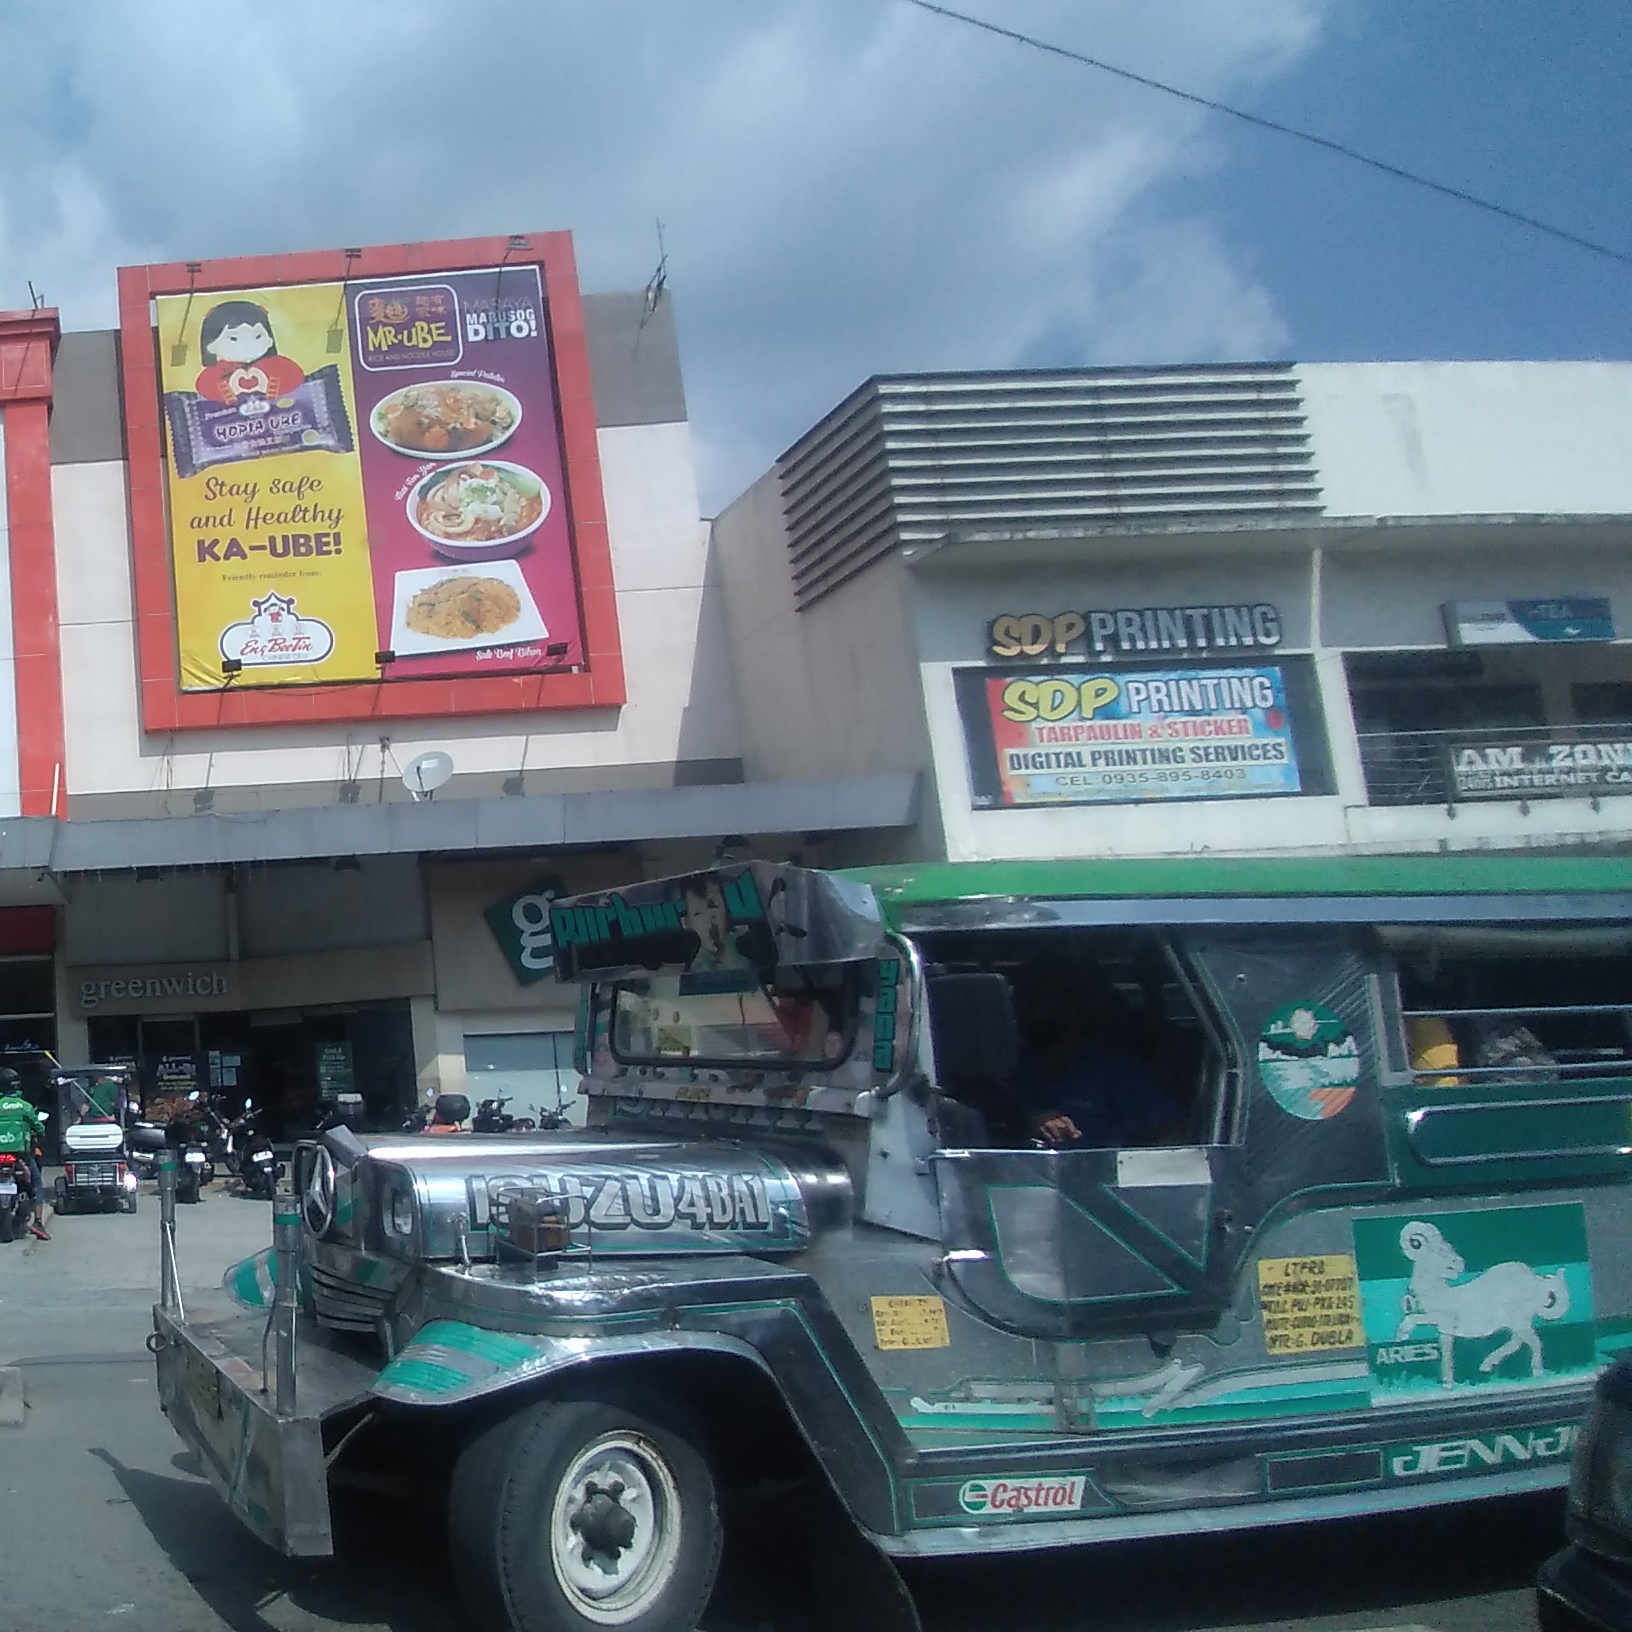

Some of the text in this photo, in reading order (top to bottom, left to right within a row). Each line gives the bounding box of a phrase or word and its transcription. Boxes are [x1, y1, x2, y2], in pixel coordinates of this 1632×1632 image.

[466, 309, 536, 325] MABUSOG
[467, 320, 538, 342] DITO!
[216, 412, 301, 441] HOPIA UBE
[204, 475, 324, 503] Stay safe
[189, 502, 345, 531] and Healthy
[196, 531, 343, 563] KA-UBE!
[990, 603, 1282, 657] SDP PRINTING
[1001, 676, 1276, 723] SDP PRINTING
[1035, 718, 1251, 744] TARPAULIN & STICKER
[1009, 742, 1286, 771] DIGITAL PRINTING SERVICES
[1493, 773, 1600, 788] INTERNET
[80, 970, 229, 1009] greenwich
[2, 1101, 24, 1110] Grab
[1376, 1343, 1441, 1365] ARIES
[989, 1480, 1077, 1509] Castrol
